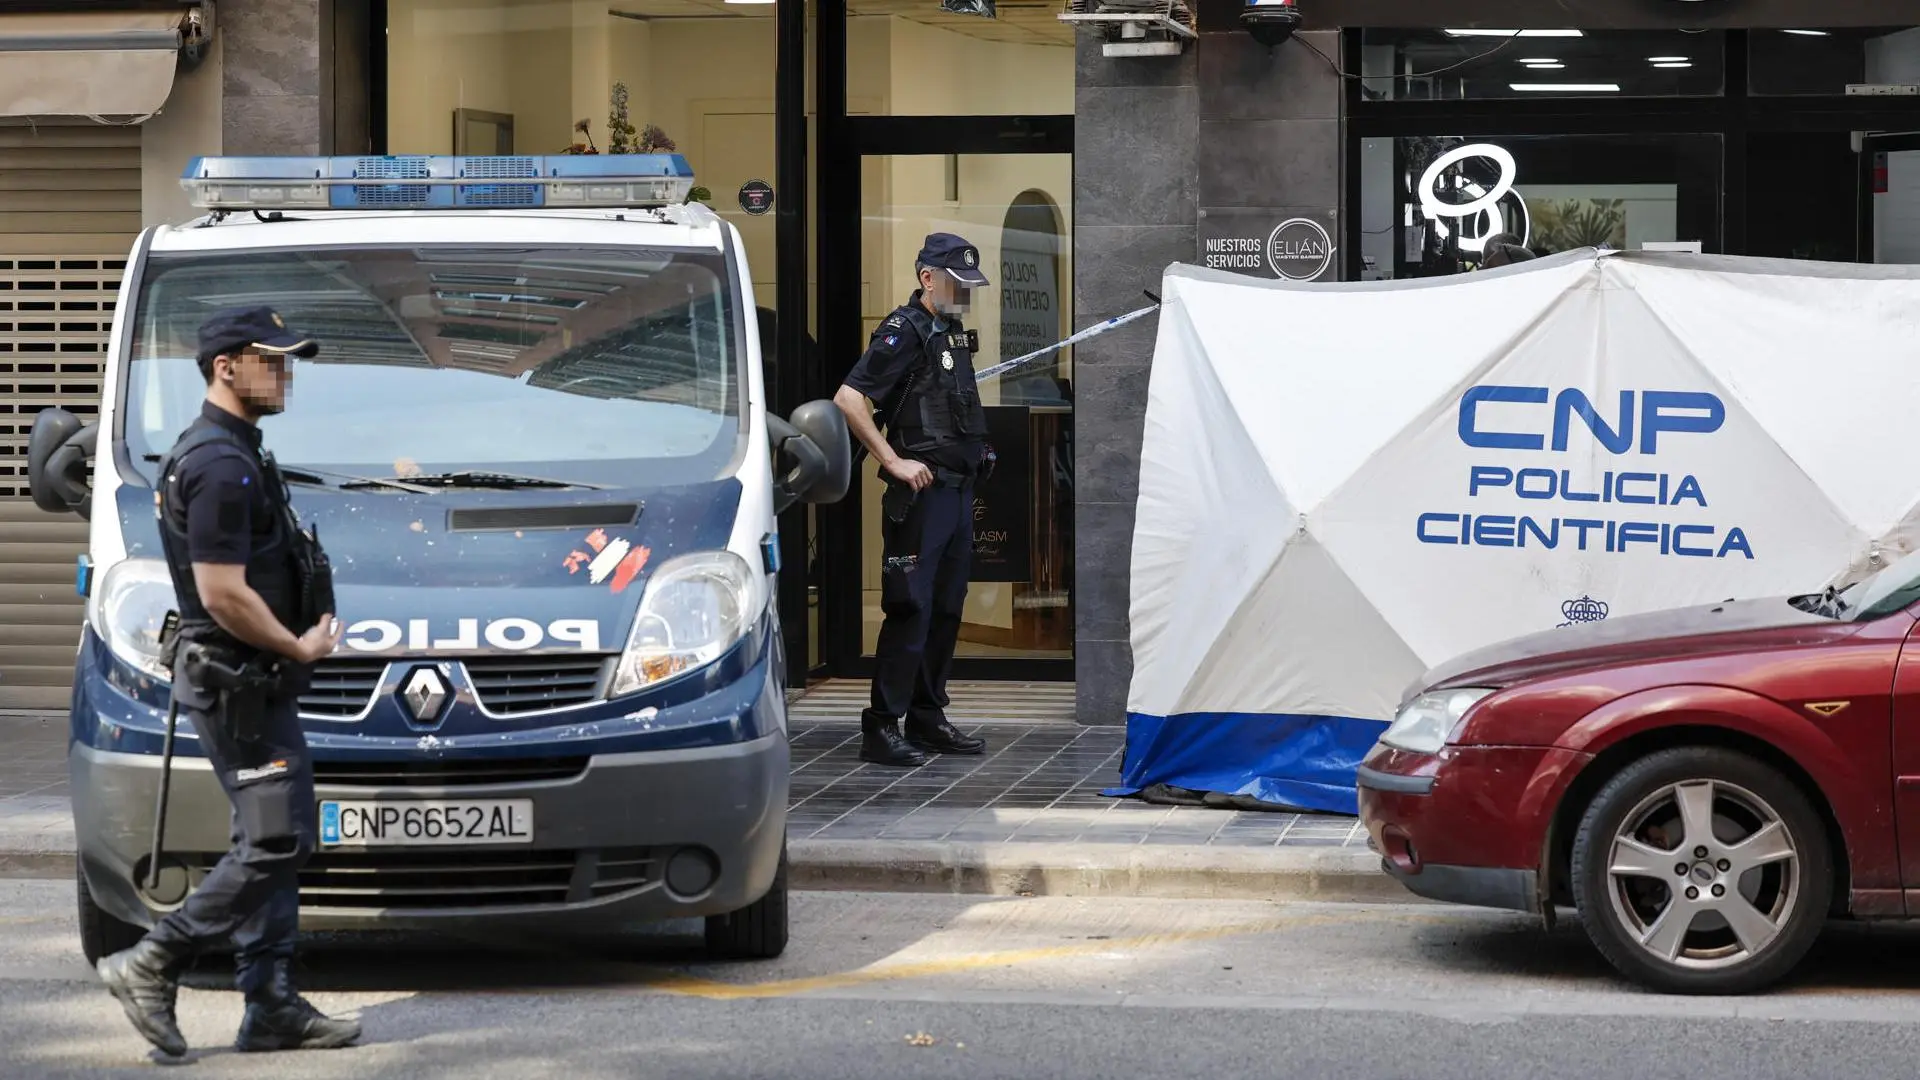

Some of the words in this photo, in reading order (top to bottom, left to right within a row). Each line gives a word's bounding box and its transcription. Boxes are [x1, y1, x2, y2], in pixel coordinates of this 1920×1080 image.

[1206, 239, 1261, 252] NUESTROS
[1206, 254, 1261, 268] SERVICIOS
[1274, 238, 1325, 255] ELIÁN
[1458, 385, 1725, 455] CNP
[1469, 465, 1708, 507] POLICIA
[1416, 512, 1755, 559] CIENTIFICA
[340, 805, 528, 839] CNP6652AL
